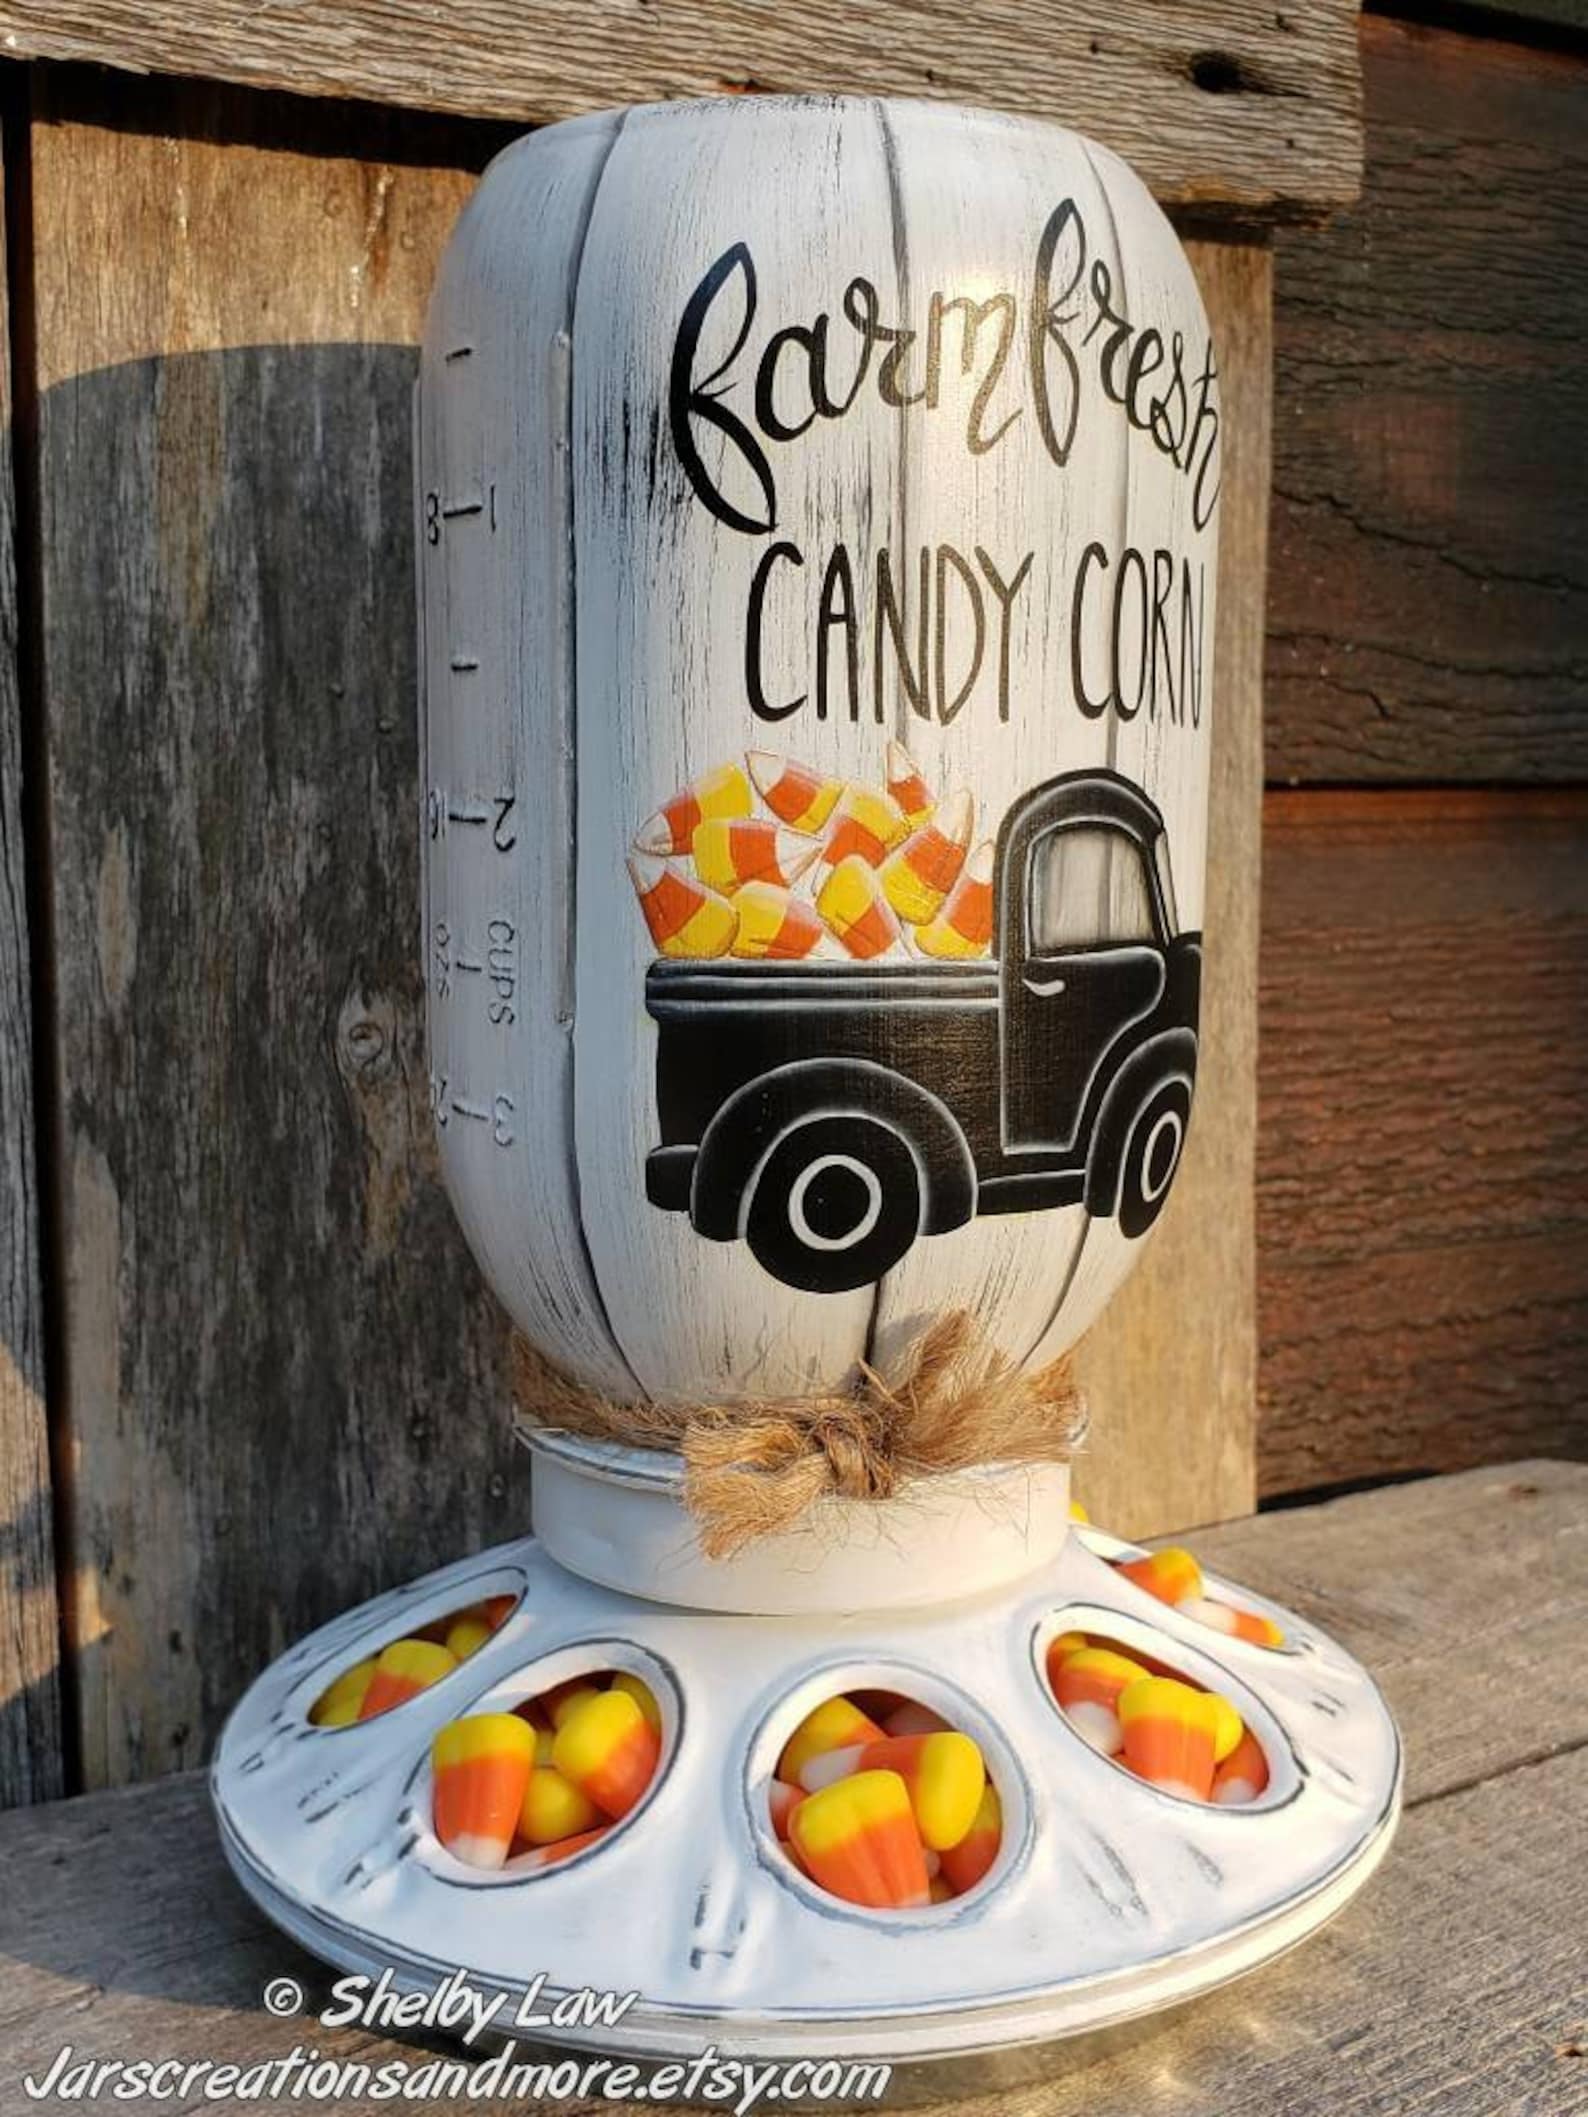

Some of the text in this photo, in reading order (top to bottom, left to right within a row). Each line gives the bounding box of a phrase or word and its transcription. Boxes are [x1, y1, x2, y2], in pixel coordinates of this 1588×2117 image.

[670, 198, 1220, 536] farm fresh
[427, 491, 439, 546] 8
[745, 541, 1205, 730] CANDY CORN
[493, 796, 516, 852] 2
[488, 920, 515, 1025] CUPS
